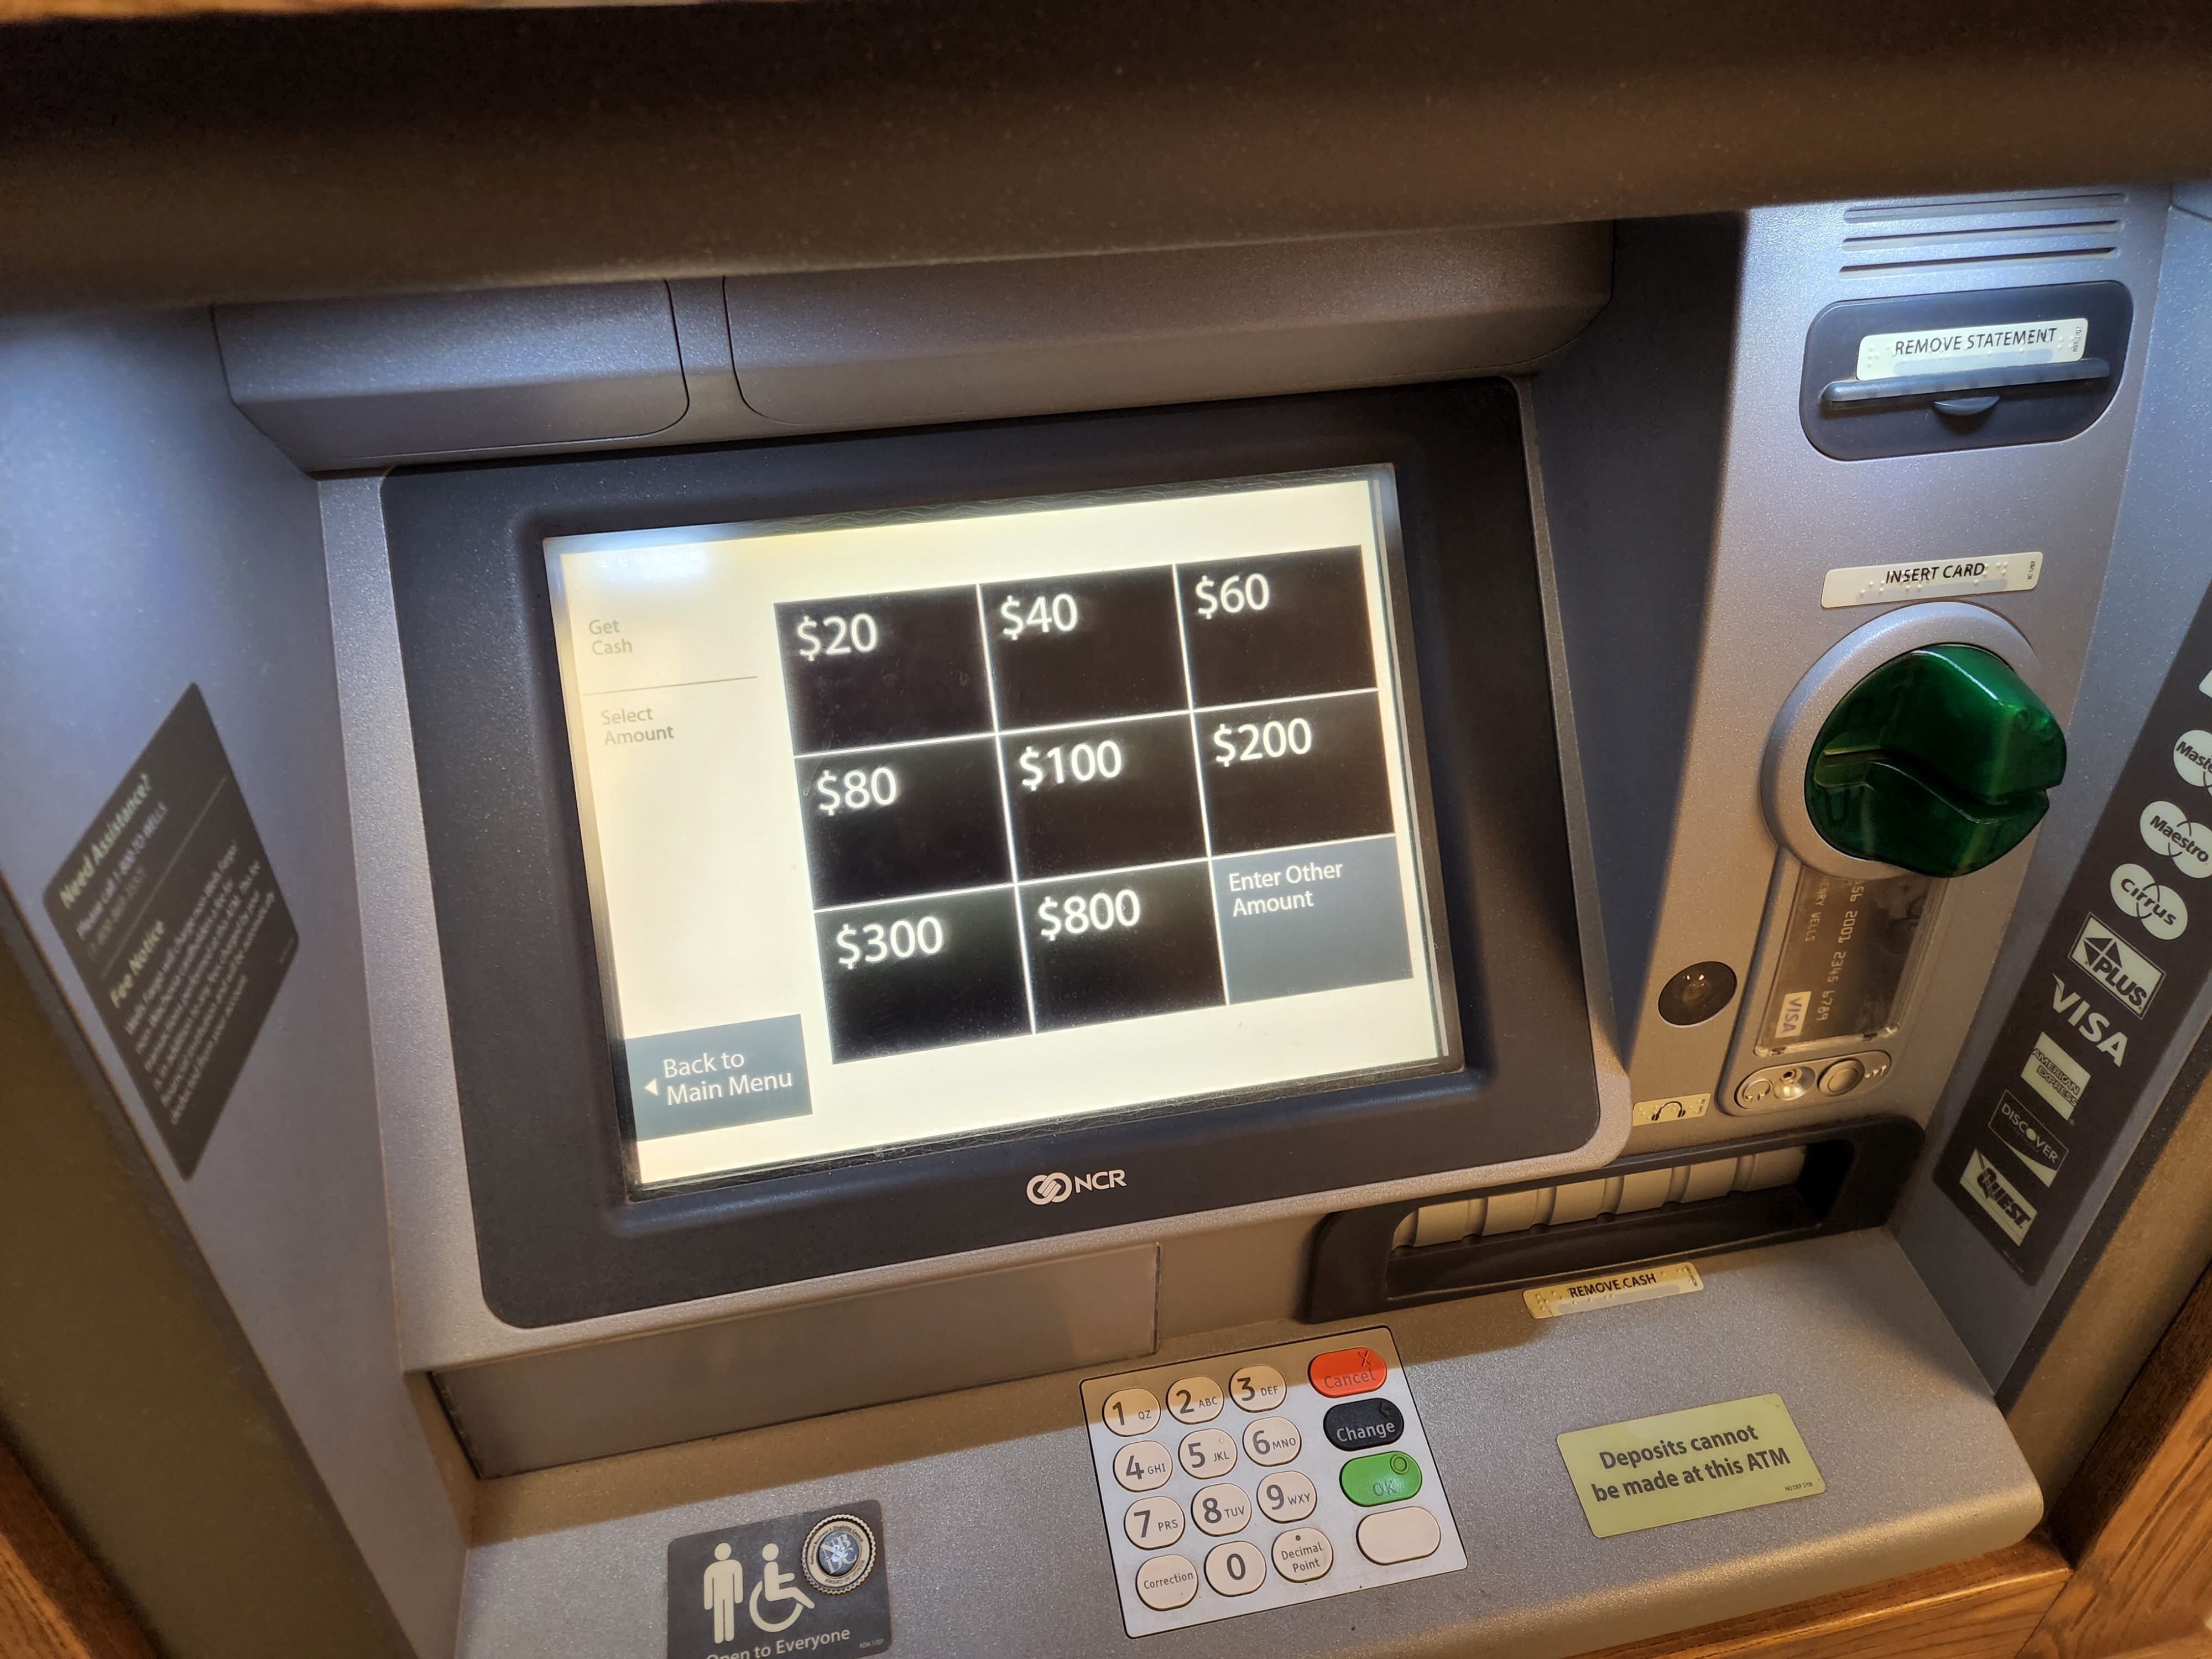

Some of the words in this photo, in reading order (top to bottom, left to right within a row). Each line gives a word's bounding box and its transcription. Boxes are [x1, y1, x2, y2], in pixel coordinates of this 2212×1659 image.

[1895, 336, 1962, 356] REMOVE
[1967, 328, 2058, 349] STATEMENT
[1885, 567, 1939, 585] INSERT
[1943, 563, 1985, 578] CARD
[1194, 572, 1270, 619] $60
[588, 619, 620, 635] Get
[999, 593, 1078, 640] $40
[591, 639, 633, 655] Cash
[797, 613, 878, 661] $20
[601, 708, 653, 726] Select
[604, 725, 674, 745] Amount
[1214, 717, 1312, 767] $200
[1019, 740, 1122, 790] $100
[817, 768, 898, 816] $80
[60, 855, 94, 911] Need
[90, 770, 151, 866] Assistance?
[2150, 816, 2208, 863] Maestro
[1229, 869, 1281, 893] Enter
[1286, 861, 1343, 884] Other
[1037, 888, 1140, 941] $800
[1232, 890, 1313, 917] Amount
[2121, 878, 2176, 926] Cirrus
[1805, 911, 1822, 942] WELLS
[1838, 910, 1858, 943] 2001
[836, 916, 945, 969] $300
[110, 968, 133, 1010] Fee
[128, 914, 164, 978] Notice
[1828, 951, 1846, 983] 2345
[2093, 961, 2148, 1007] PLUS
[1781, 996, 1803, 1034] VISA
[1816, 990, 1835, 1022] 6789
[2052, 973, 2127, 1067] VISA
[664, 1053, 717, 1078] Back
[721, 1051, 744, 1070] to
[2031, 1049, 2080, 1094] AMERICAN
[666, 1081, 723, 1105] Main
[729, 1071, 793, 1096] Menu
[2037, 1066, 2077, 1107] EXPRESS
[2001, 1103, 2059, 1165] DISCOVER
[1075, 1169, 1126, 1193] NCR
[1976, 1166, 2031, 1229] QUEST
[1569, 1281, 1622, 1298] REMOVE
[1623, 1273, 1657, 1288] CASH
[1237, 1377, 1255, 1401] 3
[1261, 1385, 1279, 1395] DEF
[1324, 1369, 1376, 1389] Cancel
[1112, 1402, 1125, 1426] 1
[1138, 1410, 1152, 1420] QZ
[1176, 1390, 1194, 1413] 2
[1198, 1397, 1218, 1407] ABC
[1252, 1430, 1271, 1454] 6
[1272, 1436, 1296, 1449] MNO
[1336, 1420, 1396, 1443] Change
[1188, 1442, 1205, 1467] 5
[1213, 1451, 1230, 1462] JKL
[1599, 1438, 1687, 1469] Deposits
[1691, 1425, 1759, 1451] cannot
[1126, 1455, 1144, 1479] 4
[1147, 1463, 1166, 1475] GHI
[1592, 1483, 1620, 1502] be
[1623, 1470, 1679, 1496] made
[1682, 1466, 1703, 1484] at
[1704, 1458, 1744, 1480] this
[1747, 1447, 1791, 1472] ATM
[1267, 1484, 1285, 1510] 9
[1287, 1493, 1310, 1505] WXY
[1373, 1481, 1395, 1496] OK
[1134, 1510, 1151, 1537] 7
[1157, 1519, 1178, 1531] PRS
[1203, 1498, 1222, 1524] 8
[1224, 1506, 1245, 1518] TUV
[1227, 1553, 1245, 1580] 0
[1281, 1542, 1323, 1561] Decimal
[1292, 1557, 1321, 1573] Point
[1143, 1571, 1193, 1590] Correction
[754, 1646, 771, 1658] to
[776, 1629, 851, 1655] Everyone
